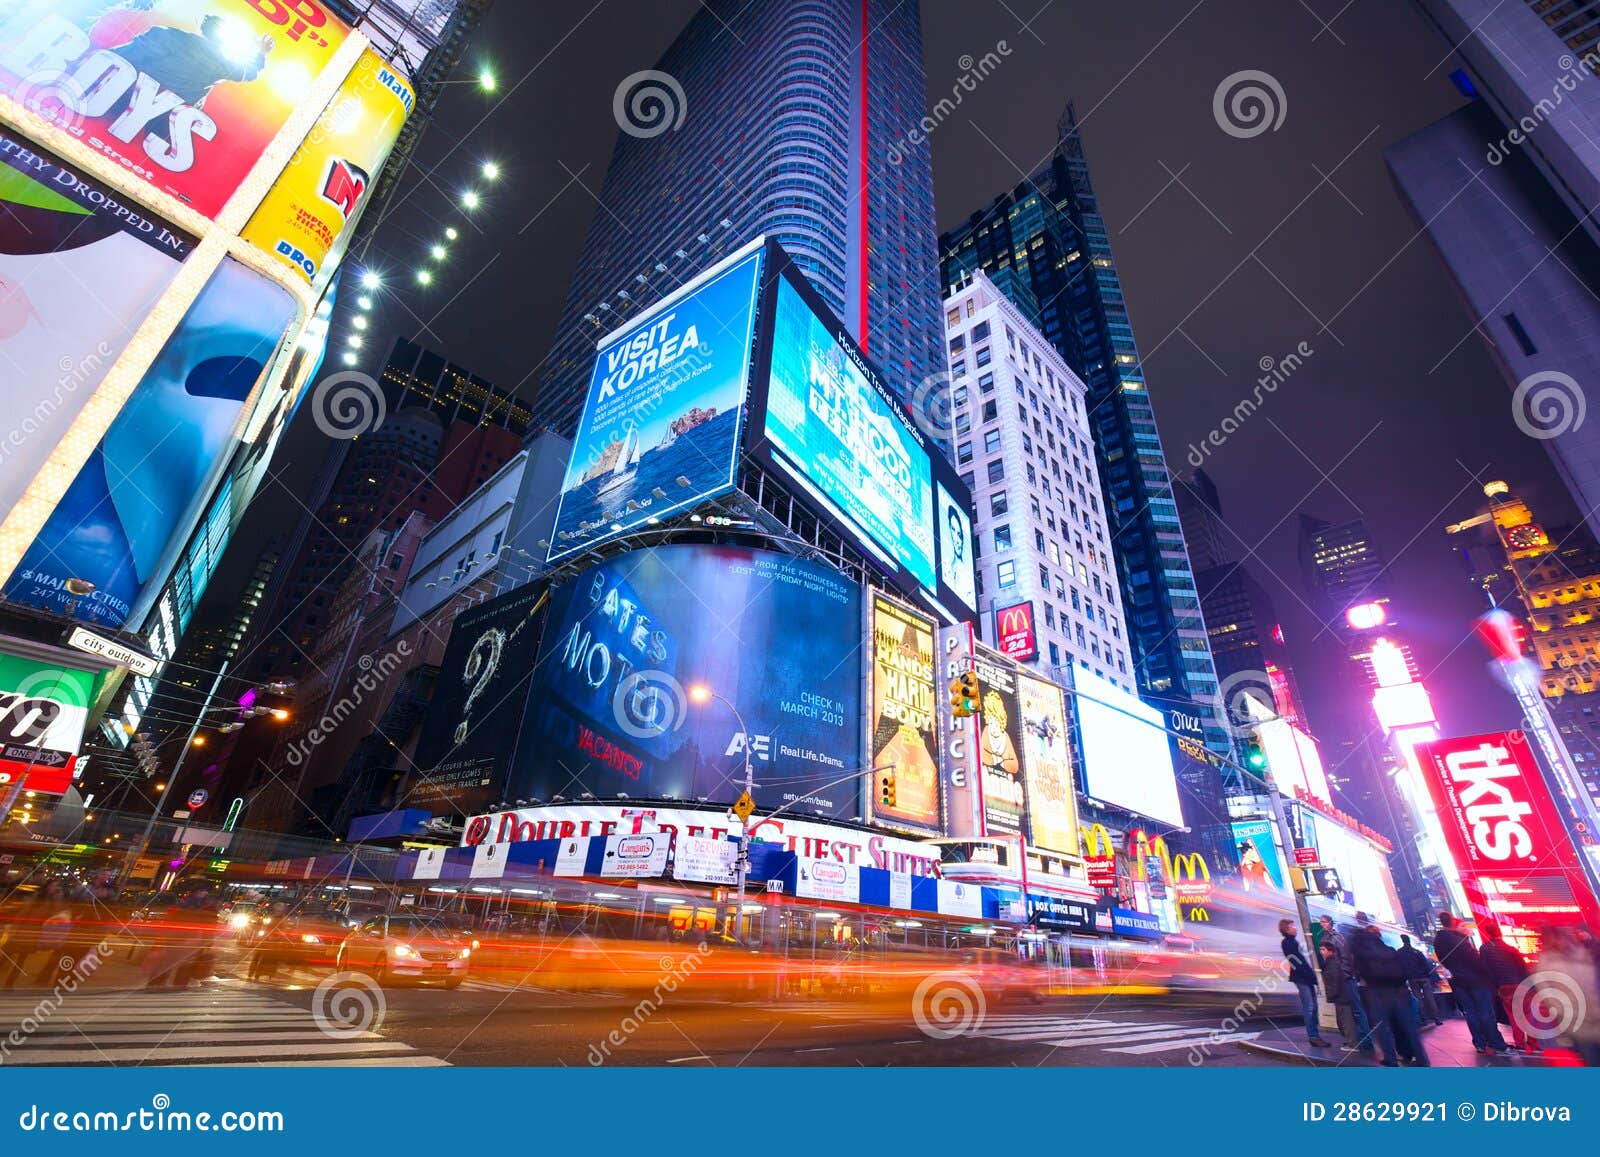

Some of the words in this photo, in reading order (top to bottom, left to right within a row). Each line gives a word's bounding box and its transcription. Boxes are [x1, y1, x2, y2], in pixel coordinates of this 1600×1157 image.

[0, 12, 218, 174] BOYS
[88, 136, 155, 180] Street
[52, 167, 155, 234] DROPPED
[155, 226, 185, 253] IN.
[608, 313, 677, 374] VISIT
[597, 324, 699, 404] KOREA
[838, 331, 871, 379] Horizon
[870, 372, 893, 406] Travel
[729, 565, 756, 576] "LOST"
[757, 570, 772, 579] AND
[804, 580, 824, 592] NIGHT
[755, 559, 778, 570] FROM
[781, 565, 796, 575] THE
[798, 570, 839, 591] PRODUCERS
[839, 585, 848, 594] OF
[30, 586, 55, 599] 247
[57, 593, 82, 608] Wet
[85, 603, 106, 617] 44th
[590, 570, 668, 662] BATES
[84, 637, 105, 652] city
[107, 649, 146, 669] outdoor
[1004, 631, 1028, 642] OPEN
[1006, 647, 1033, 659] OURS
[1008, 638, 1026, 652] 24
[878, 645, 933, 682] HANDS
[801, 692, 833, 710] CHECK
[835, 702, 844, 714] IN
[886, 667, 930, 711] HARD
[780, 701, 818, 719] MARCH
[821, 710, 844, 727] 2013
[882, 700, 931, 732] BODY
[945, 636, 967, 788] PAACE
[11, 749, 31, 759] ONE
[39, 751, 60, 763] WAY
[578, 724, 644, 781] VACANCY
[780, 745, 800, 758] Real
[801, 749, 819, 762] Life.
[819, 753, 845, 768] Drama.
[1445, 743, 1533, 861] tkts
[620, 842, 650, 854] Langan's
[1454, 807, 1474, 845] Development
[1468, 845, 1480, 861] Fund
[867, 836, 942, 880] SUITES
[1035, 901, 1048, 912] BOX
[1050, 903, 1068, 914] OFFICE
[1115, 915, 1133, 928] MONEY
